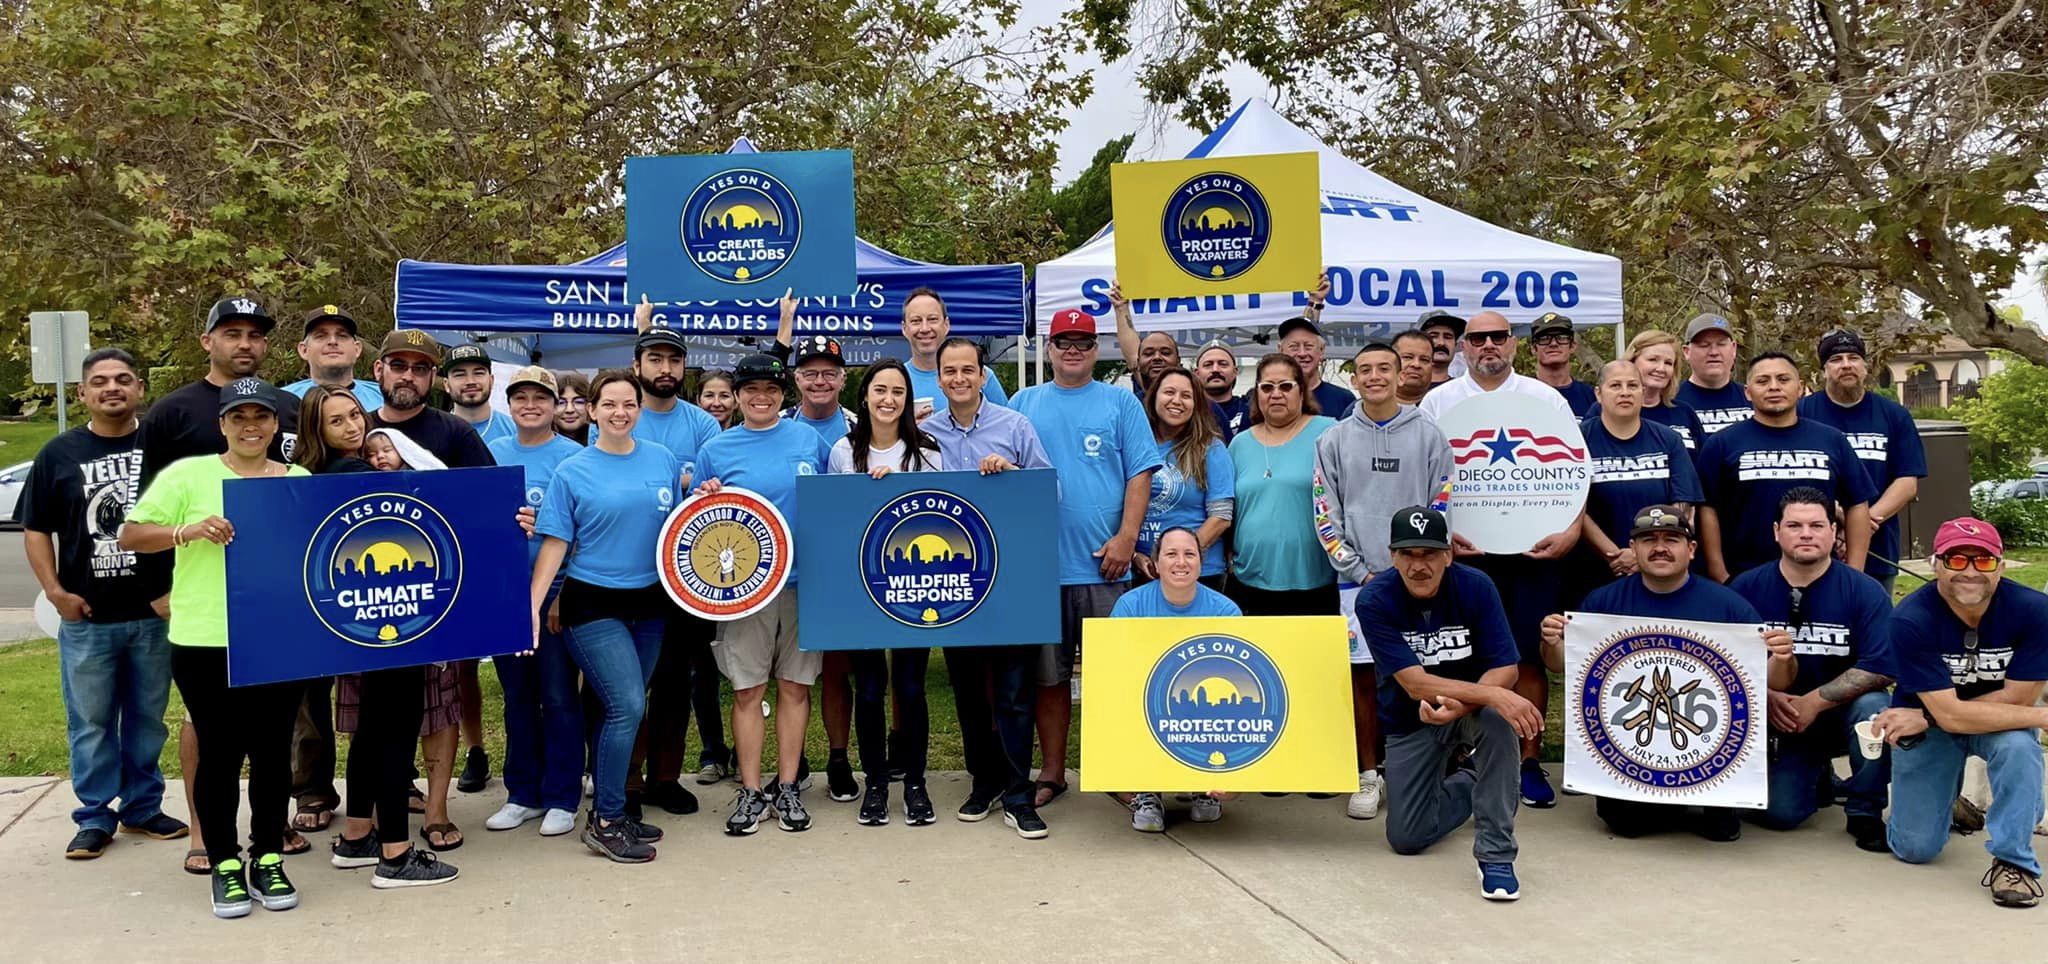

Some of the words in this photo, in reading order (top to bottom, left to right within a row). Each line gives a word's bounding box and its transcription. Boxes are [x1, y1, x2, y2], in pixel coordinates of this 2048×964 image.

[708, 176, 734, 192] YES
[738, 175, 758, 185] ON
[761, 180, 771, 190] D
[1186, 180, 1208, 196] YES
[1212, 178, 1231, 188] ON
[1234, 183, 1243, 193] D
[718, 239, 765, 250] CREATE
[1181, 237, 1253, 253] PROTECT
[697, 250, 746, 263] LOCAL
[748, 248, 786, 261] JOBS
[1185, 250, 1249, 262] TAXPAYERS
[545, 280, 610, 305] SAN
[1293, 266, 1460, 308] OCAL
[1480, 270, 1580, 309] 206
[552, 312, 668, 329] BUILDIG
[679, 313, 768, 331] TRADES
[796, 315, 874, 331] NIONS
[1739, 453, 1829, 469] SMART
[1459, 468, 1506, 482] DIEGO
[1510, 466, 1586, 481] COUNTY'S
[1452, 483, 1481, 492] DING
[1487, 482, 1529, 492] TRADES
[1533, 482, 1580, 491] UNIONS
[340, 503, 374, 525] YES
[380, 501, 406, 515] ON
[410, 507, 423, 520] D
[890, 499, 920, 518] YES
[925, 497, 948, 510] ON
[951, 505, 963, 516] D
[1481, 500, 1519, 509] Display.
[1522, 500, 1548, 508] Every
[1551, 499, 1572, 508] Day.
[735, 510, 748, 522] OF
[680, 508, 732, 546] BROTHERHOOD
[747, 517, 772, 563] ELECTRICAL
[678, 549, 723, 600] INTERNATIONAL
[733, 566, 768, 597] WORKERS
[888, 573, 970, 589] WILDFIRE
[337, 583, 435, 608] CLIMATE
[885, 588, 974, 603] RESPONSE
[354, 602, 419, 621] ACTION
[1177, 643, 1206, 661] YES
[1212, 642, 1235, 654] ON
[1239, 649, 1250, 660] D
[1592, 643, 1627, 680] SHEET
[1628, 636, 1678, 650] METAL
[1680, 640, 1743, 695] WORKERS'
[1633, 656, 1697, 674] CHARTERED
[1610, 681, 1718, 734] 206
[1159, 718, 1235, 732] PROTECT
[1237, 718, 1274, 732] OUR
[1167, 733, 1267, 743] INFRASTRUCTURE
[1585, 706, 1605, 741] SAN
[1600, 743, 1657, 786] DIEGO,
[1663, 718, 1746, 786] CALIFORNIA
[1630, 744, 1653, 761] JULY
[1675, 748, 1701, 763] 1919
